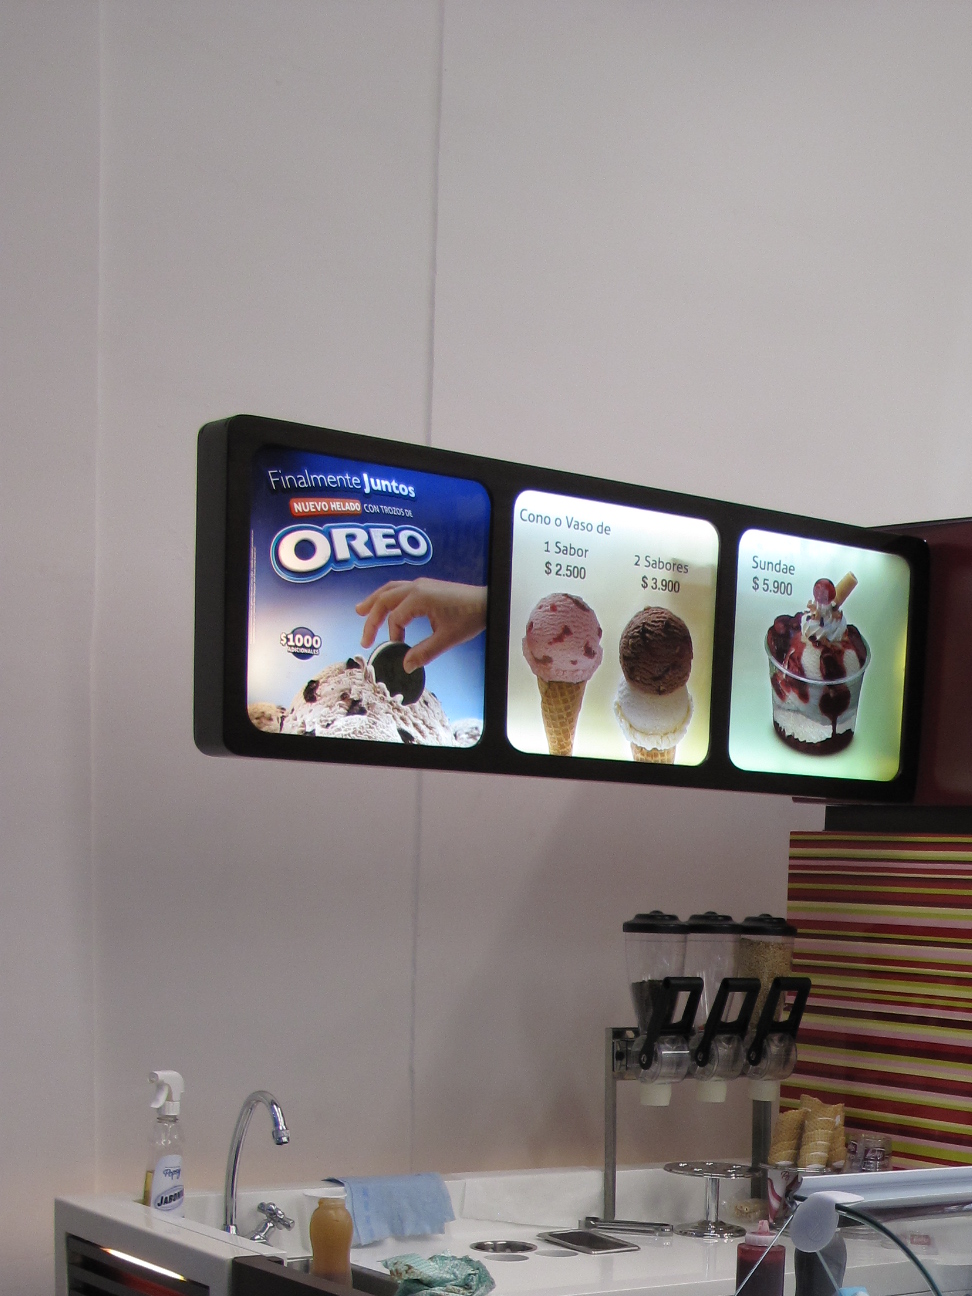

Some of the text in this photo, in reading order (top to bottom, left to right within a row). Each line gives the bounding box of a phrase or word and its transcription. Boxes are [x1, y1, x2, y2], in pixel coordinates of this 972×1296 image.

[268, 469, 416, 497] Finalmente Juntos
[293, 501, 413, 518] NUEVO HELADO CON TROZOS DE
[519, 508, 611, 535] Cono o Vaso de
[278, 527, 428, 573] OREO
[544, 541, 589, 558] 1 Sabor
[555, 562, 586, 580] 2.500
[633, 554, 689, 574] 2 Sabores
[751, 555, 796, 576] Sundae
[650, 576, 680, 593] 3.900
[762, 578, 793, 596] 5.900
[280, 632, 321, 649] $1000
